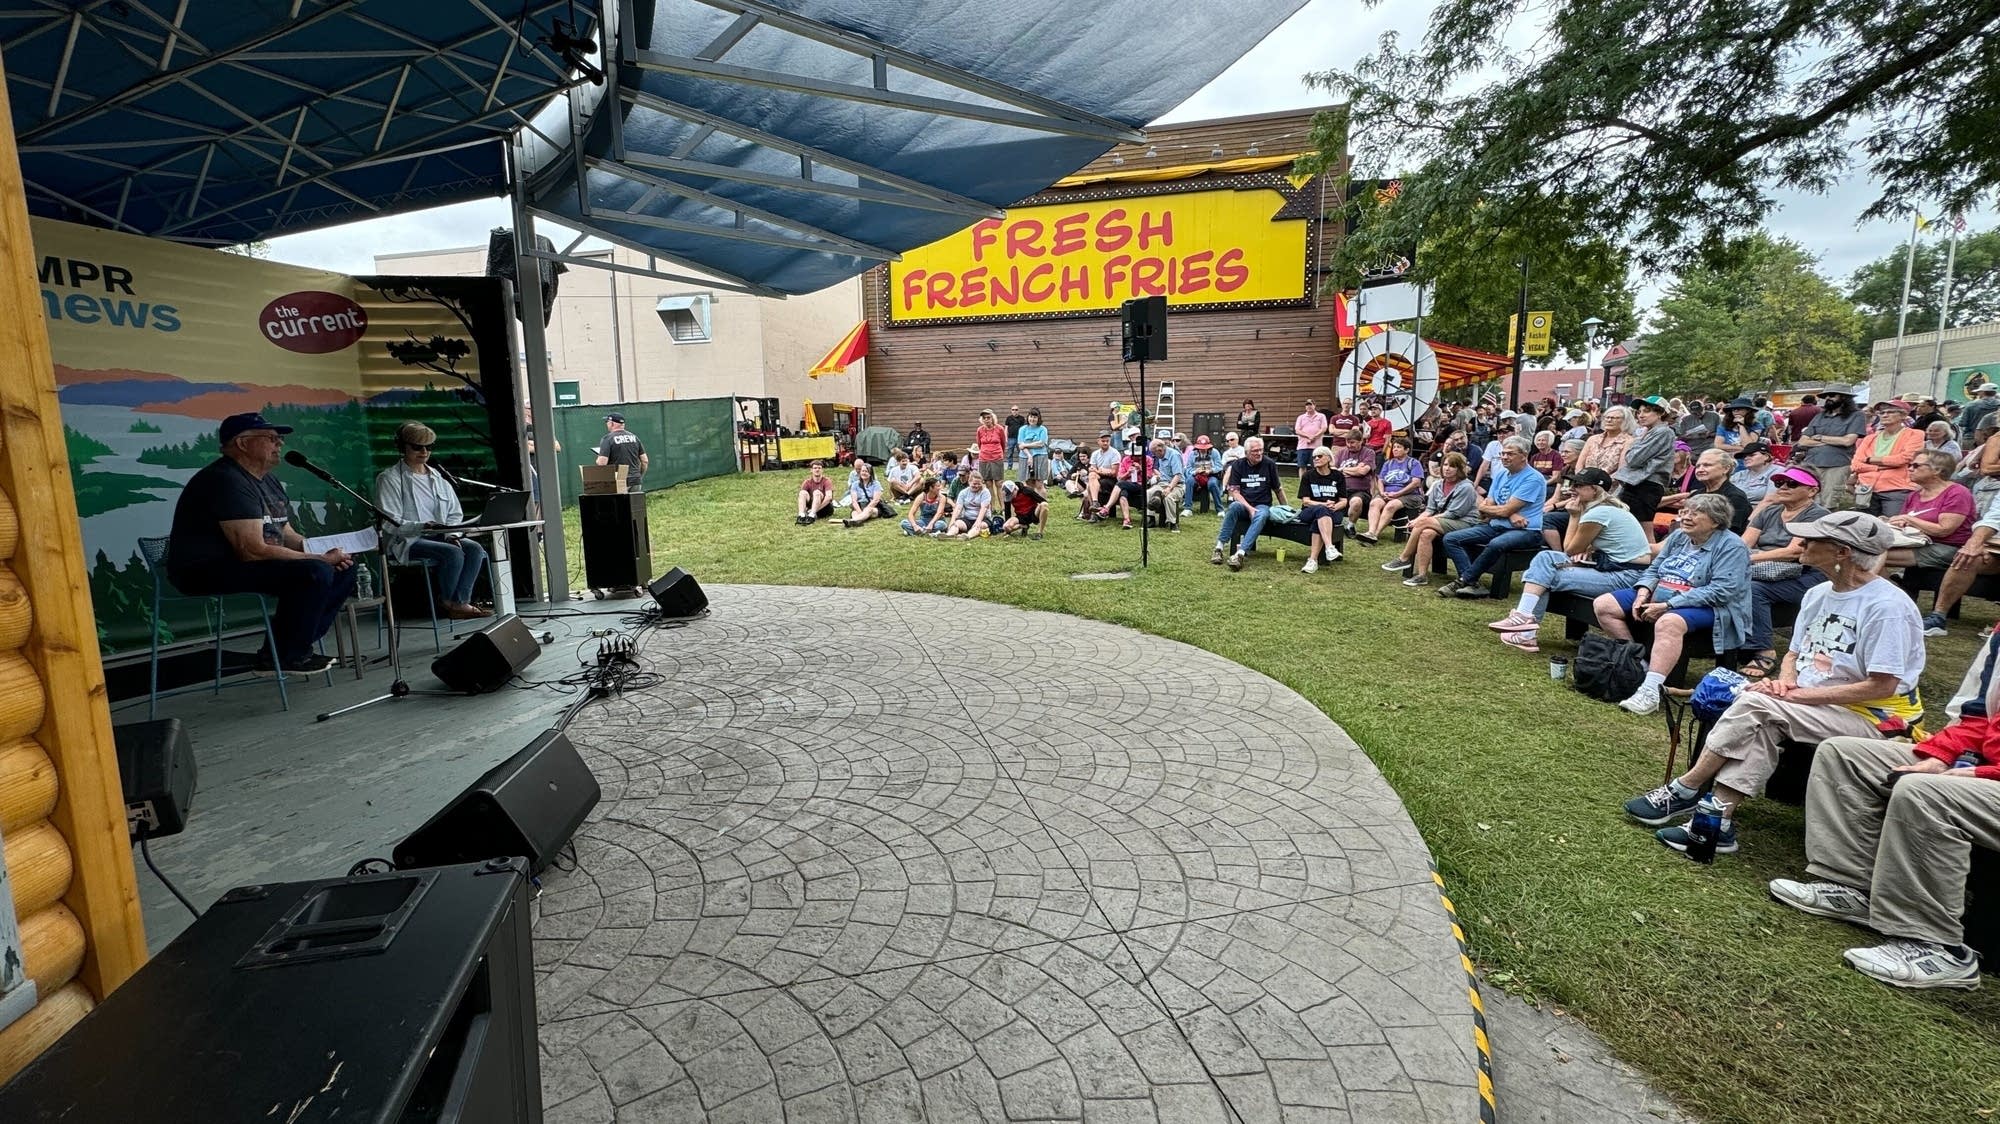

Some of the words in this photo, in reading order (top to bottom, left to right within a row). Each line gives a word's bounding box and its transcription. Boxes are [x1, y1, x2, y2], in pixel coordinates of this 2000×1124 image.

[971, 208, 1173, 262] FRESH
[37, 256, 136, 295] MPR
[902, 262, 1090, 312] FRENCH
[1103, 248, 1249, 299] FRIES
[41, 289, 182, 332] news
[275, 305, 300, 318] the
[613, 434, 637, 445] CREW
